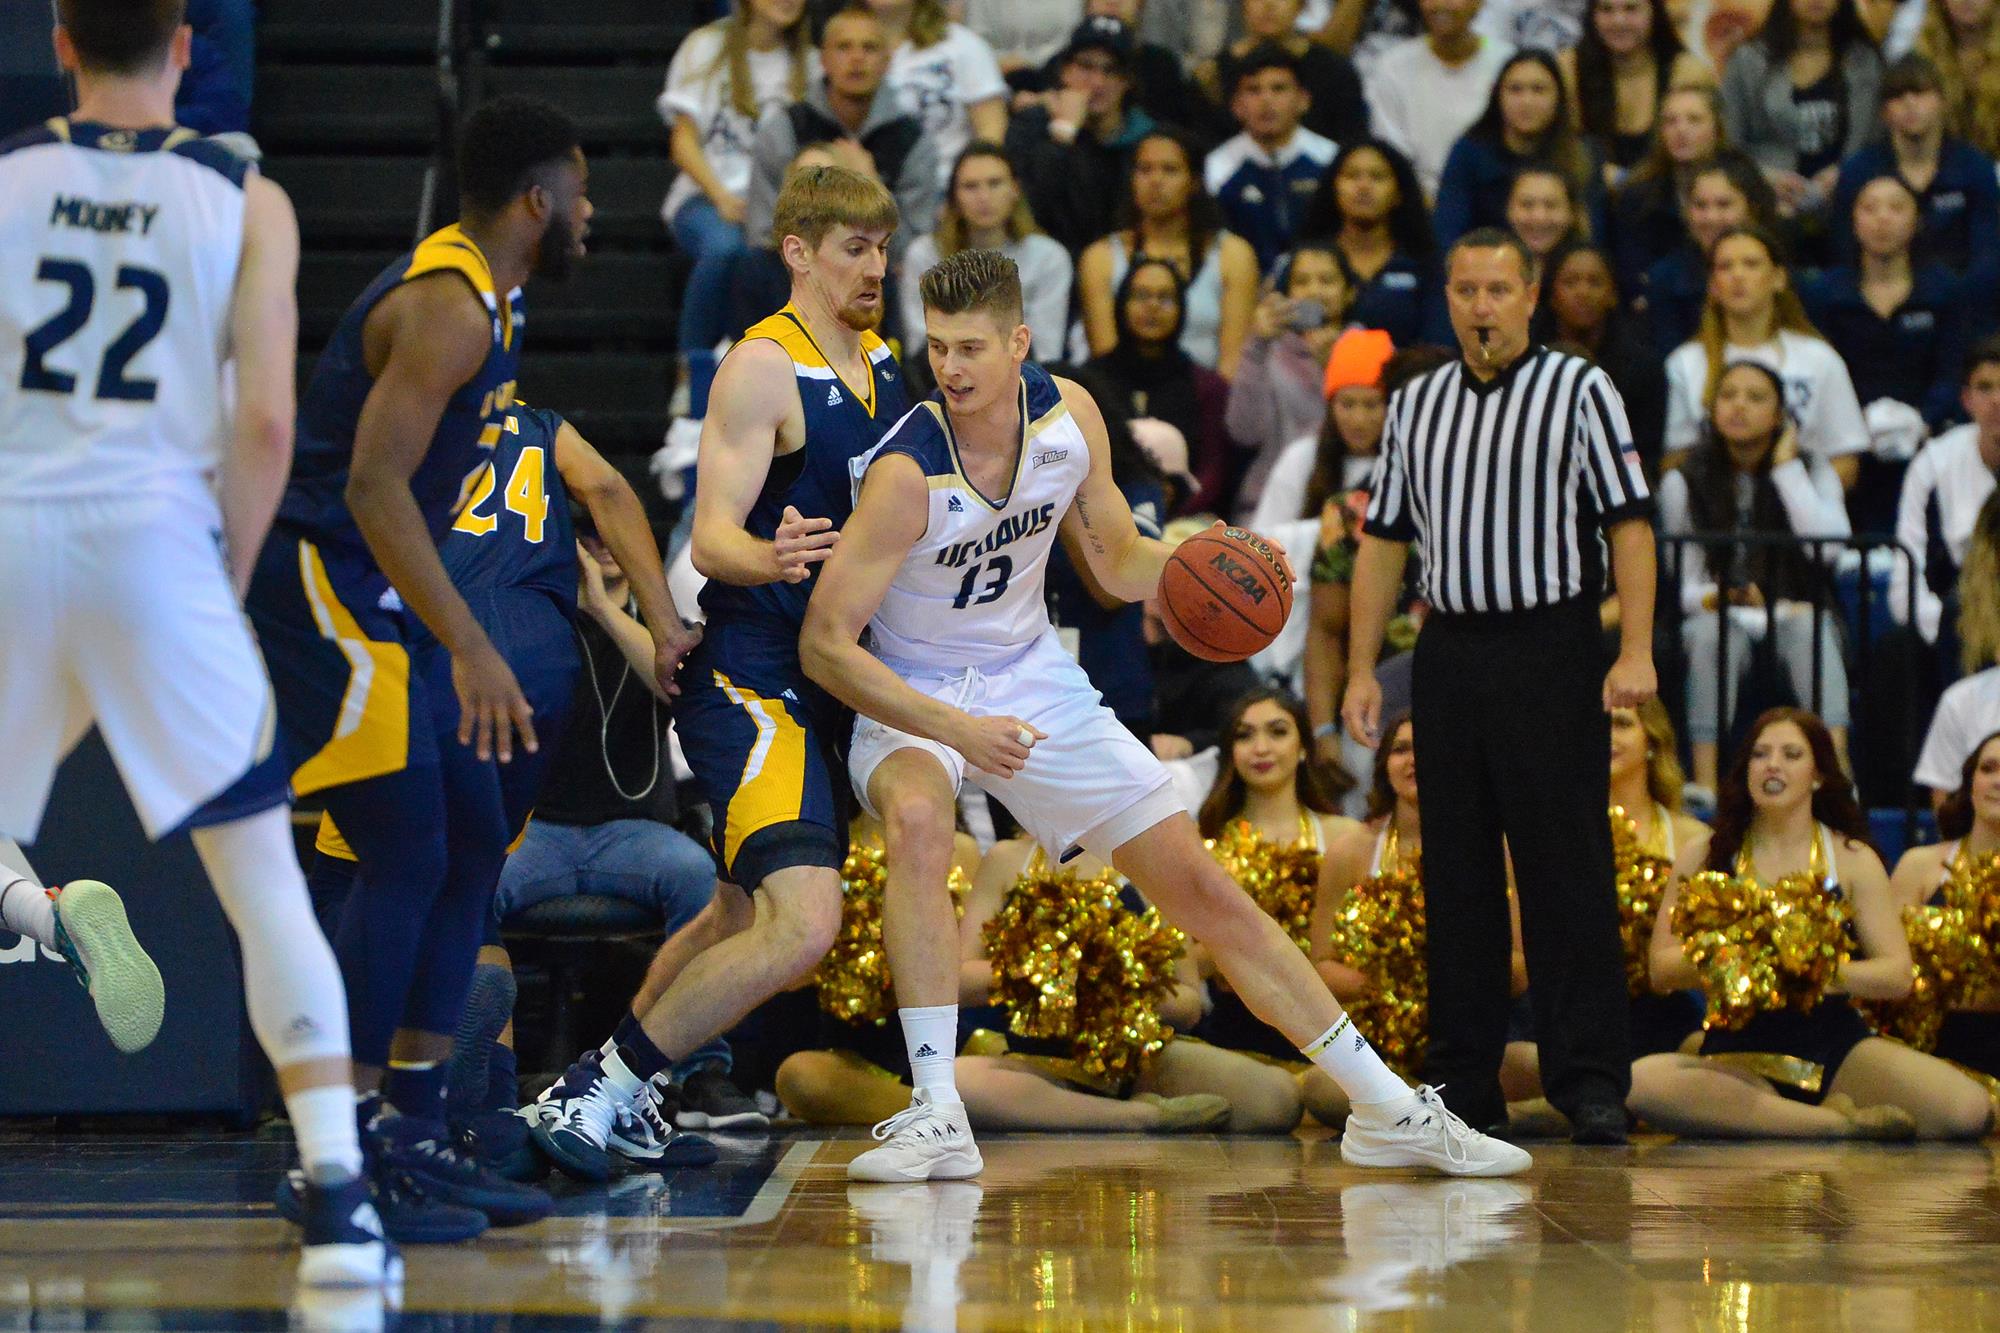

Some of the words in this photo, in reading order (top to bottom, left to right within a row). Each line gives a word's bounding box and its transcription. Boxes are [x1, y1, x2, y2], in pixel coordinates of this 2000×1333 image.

[51, 193, 159, 236] MOONEY
[20, 256, 170, 402] 22
[451, 446, 550, 543] 24
[952, 554, 1013, 609] 13
[1209, 551, 1268, 605] NCAA
